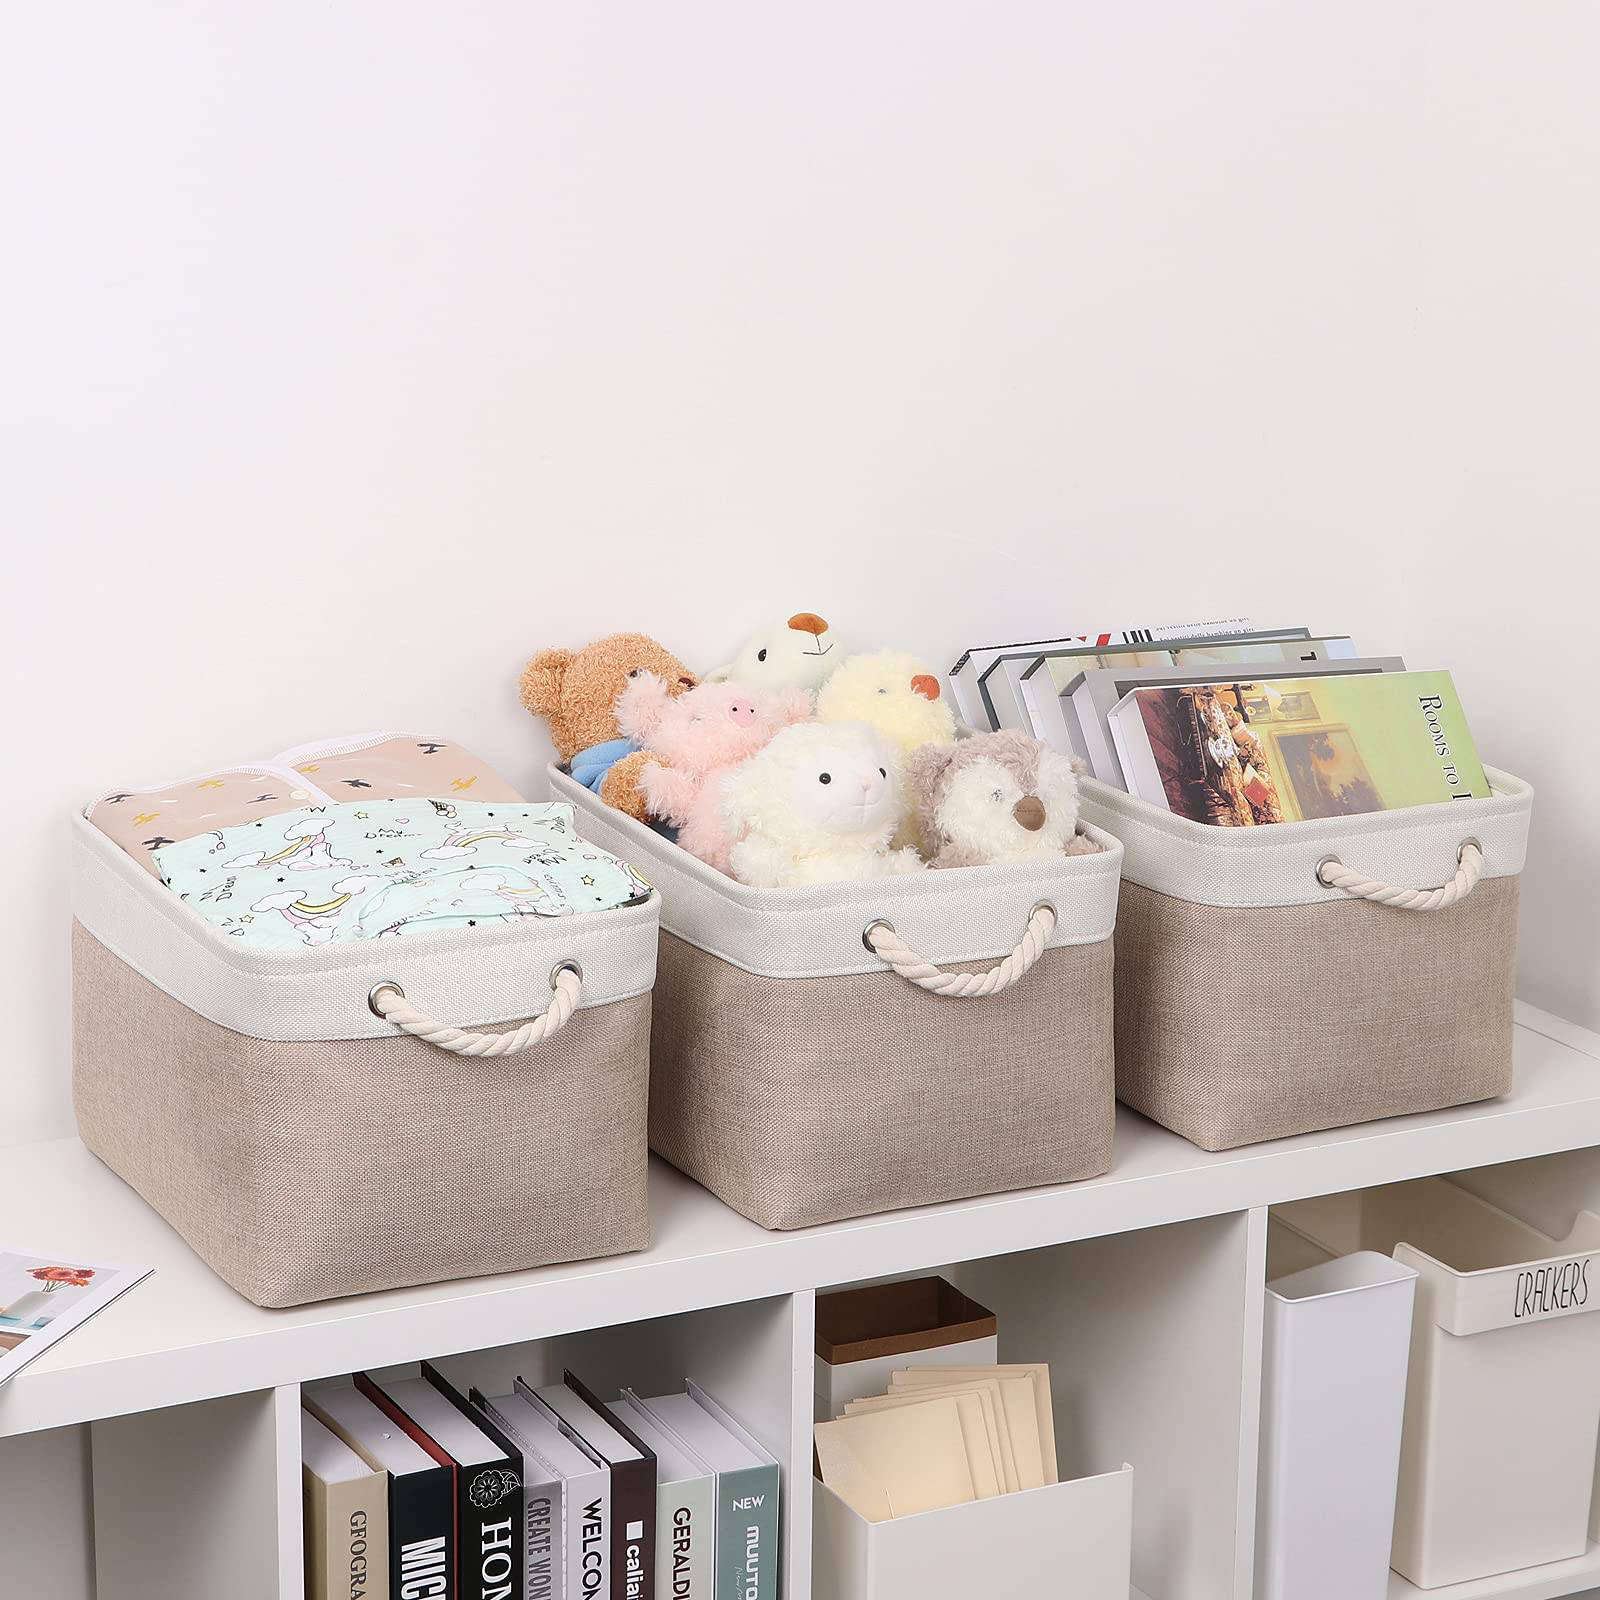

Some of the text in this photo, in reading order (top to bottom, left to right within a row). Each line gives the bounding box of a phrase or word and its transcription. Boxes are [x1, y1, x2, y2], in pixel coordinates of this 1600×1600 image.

[1419, 695, 1450, 756] ROOMS
[1443, 763, 1459, 785] TO
[1514, 1259, 1591, 1318] CRACKERS
[527, 1497, 552, 1556] CREATE
[732, 1495, 765, 1512] NEW
[401, 1536, 447, 1600] MIC
